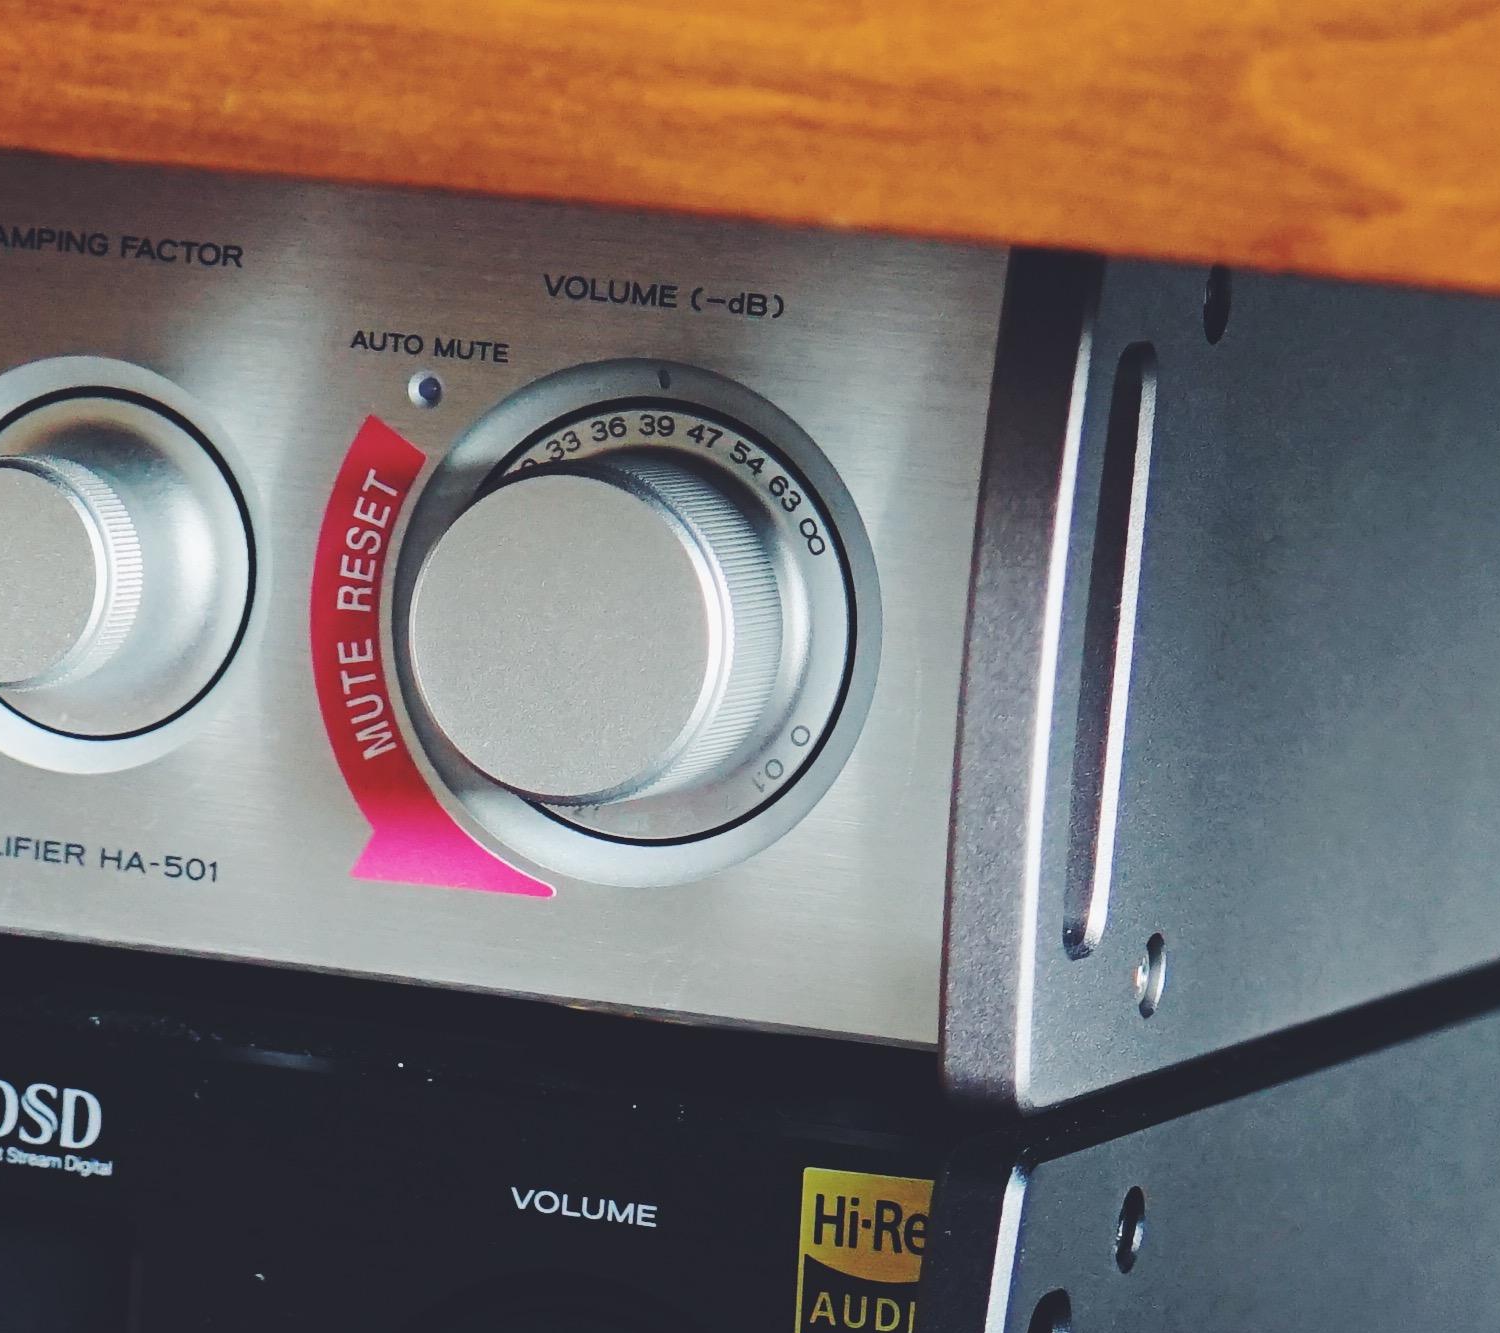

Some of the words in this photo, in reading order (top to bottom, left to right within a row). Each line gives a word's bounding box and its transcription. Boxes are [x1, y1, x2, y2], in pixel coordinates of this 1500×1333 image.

[120, 235, 243, 267] FACTOR
[543, 273, 678, 309] VOLUME
[350, 330, 424, 356] AUTO
[433, 337, 510, 363] MUTE
[546, 430, 581, 461] 33
[591, 415, 627, 442] 36
[638, 413, 675, 438] 39
[686, 423, 724, 449] 47
[729, 440, 764, 478] 54
[768, 474, 802, 513] 63
[336, 468, 399, 613] RESET
[337, 637, 398, 761] MUTE
[99, 848, 218, 883] HA-501
[6, 1146, 62, 1169] Stream
[63, 1154, 114, 1178] Digital
[510, 1185, 659, 1228] VOLUME
[813, 1192, 929, 1256] Hi-Re
